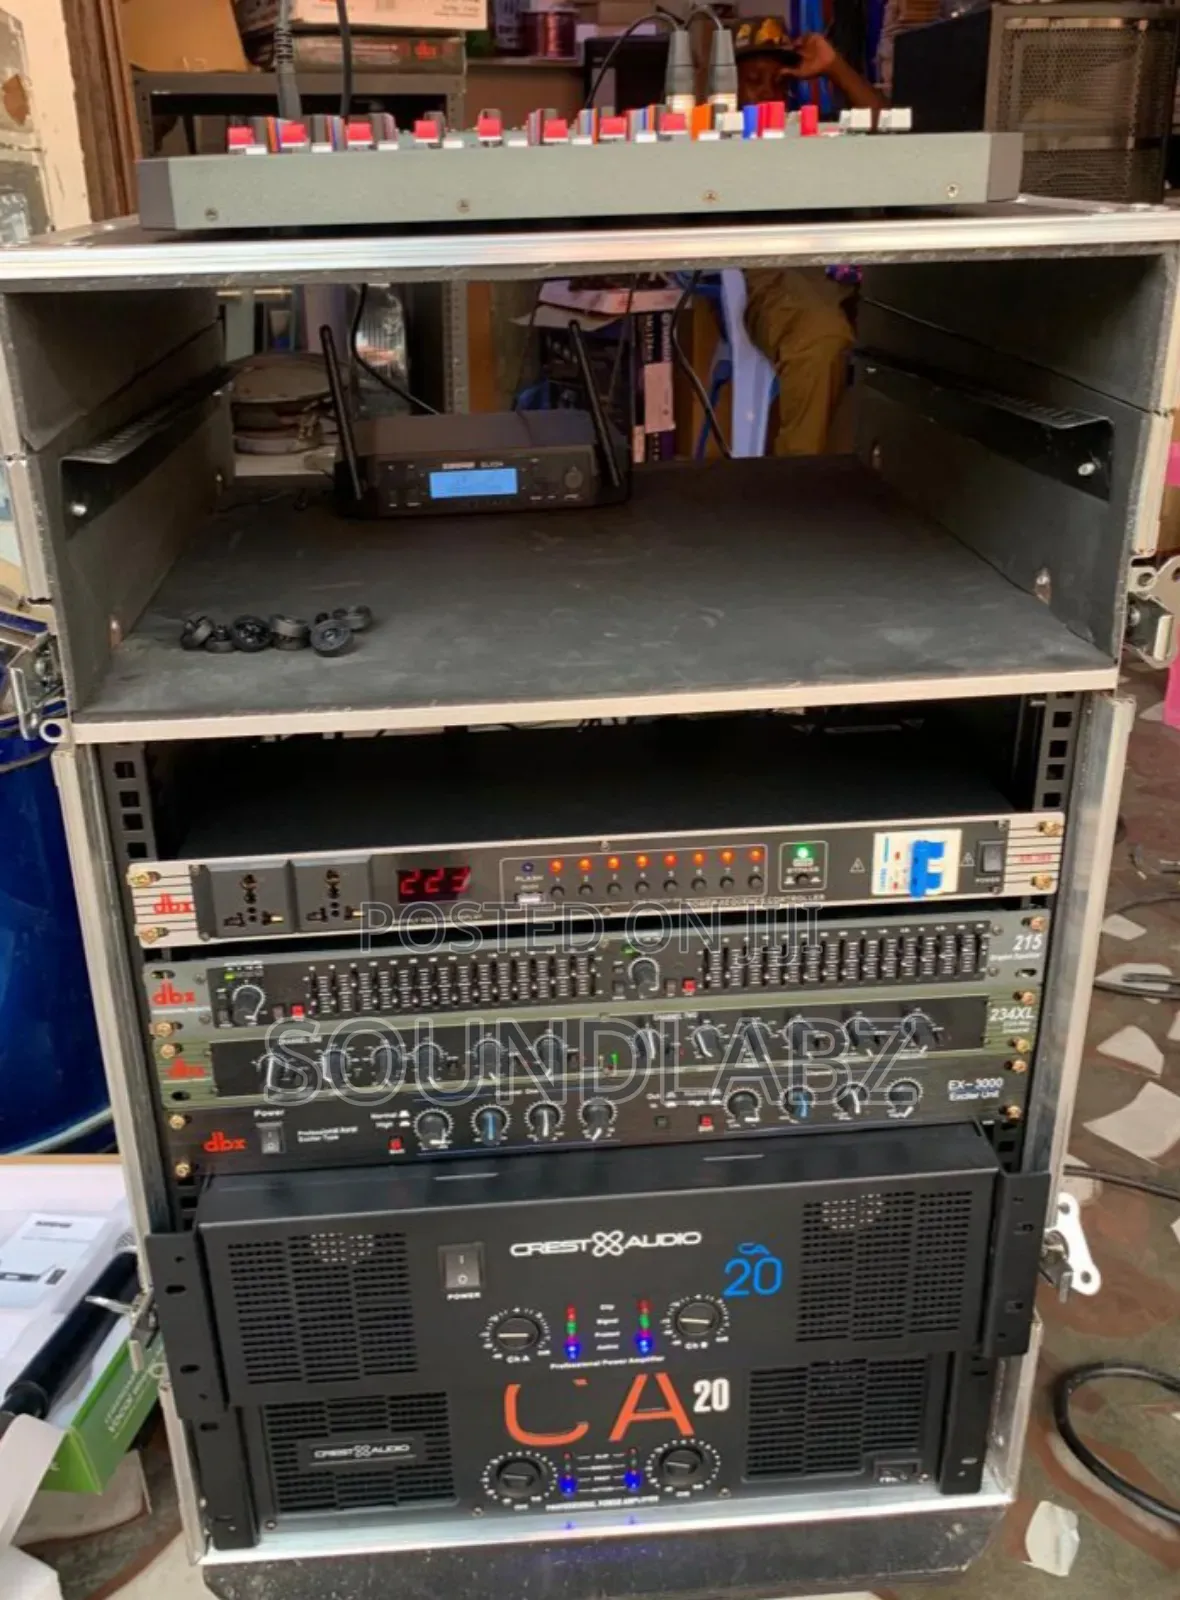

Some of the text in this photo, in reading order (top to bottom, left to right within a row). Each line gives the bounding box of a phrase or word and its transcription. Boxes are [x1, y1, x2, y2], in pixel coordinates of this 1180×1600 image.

[1012, 934, 1043, 951] 215
[153, 976, 195, 1004] dbx
[989, 1007, 1034, 1022] 234XL
[203, 1131, 247, 1152] dbx
[510, 1231, 702, 1257] CREST AUDIO
[723, 1256, 783, 1297] 20
[693, 1377, 731, 1413] 20
[503, 1371, 695, 1447] CA
